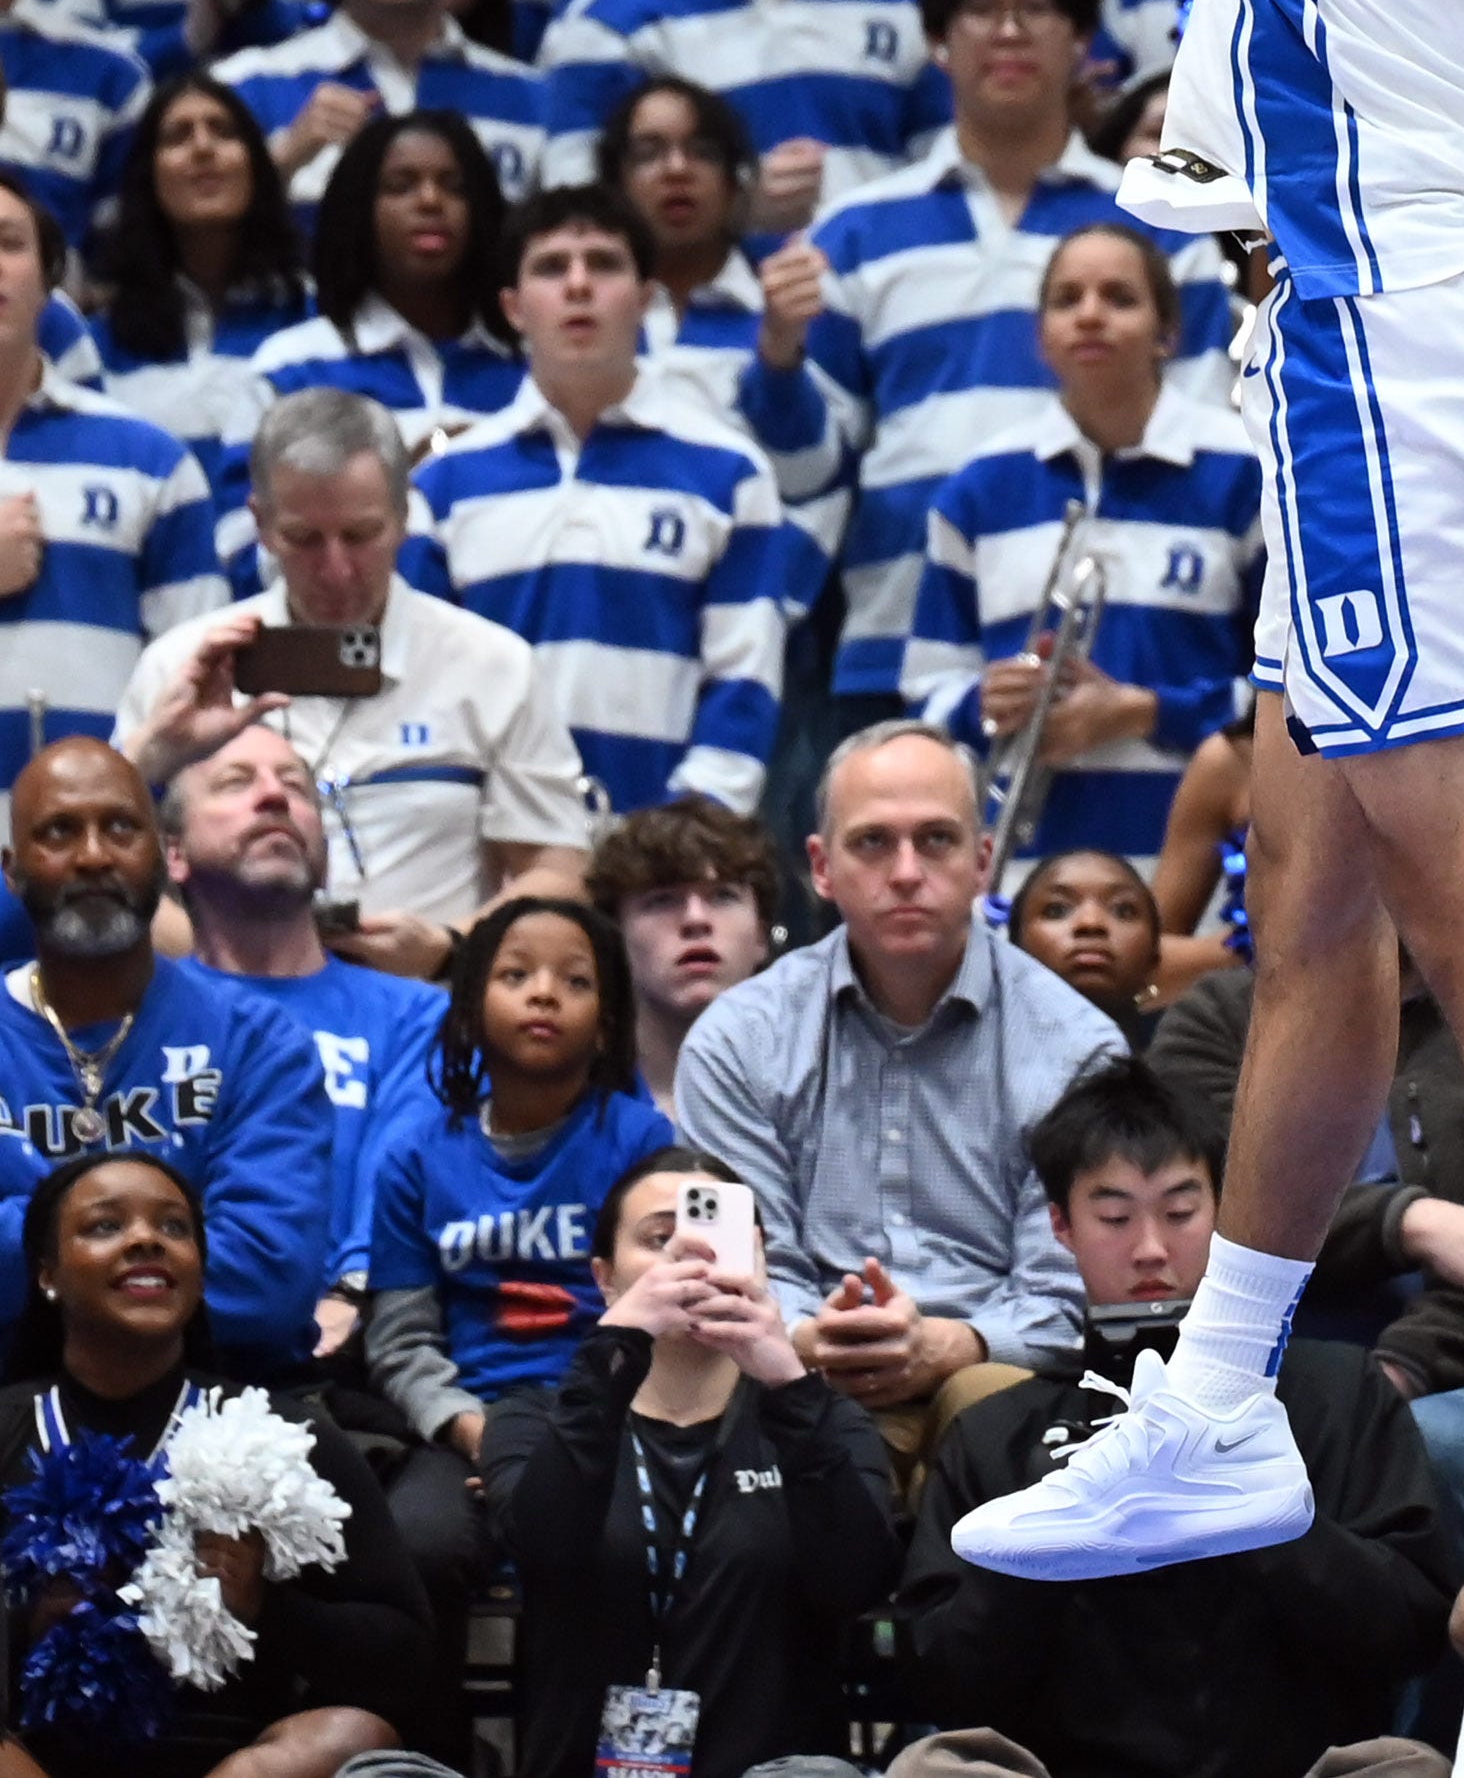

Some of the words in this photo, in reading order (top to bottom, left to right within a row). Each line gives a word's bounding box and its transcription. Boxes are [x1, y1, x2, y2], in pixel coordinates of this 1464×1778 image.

[47, 114, 85, 158] D
[82, 485, 119, 530] D
[644, 507, 685, 557] D
[1161, 542, 1205, 594] D
[1314, 589, 1383, 658] D
[438, 1202, 588, 1272] DUKE
